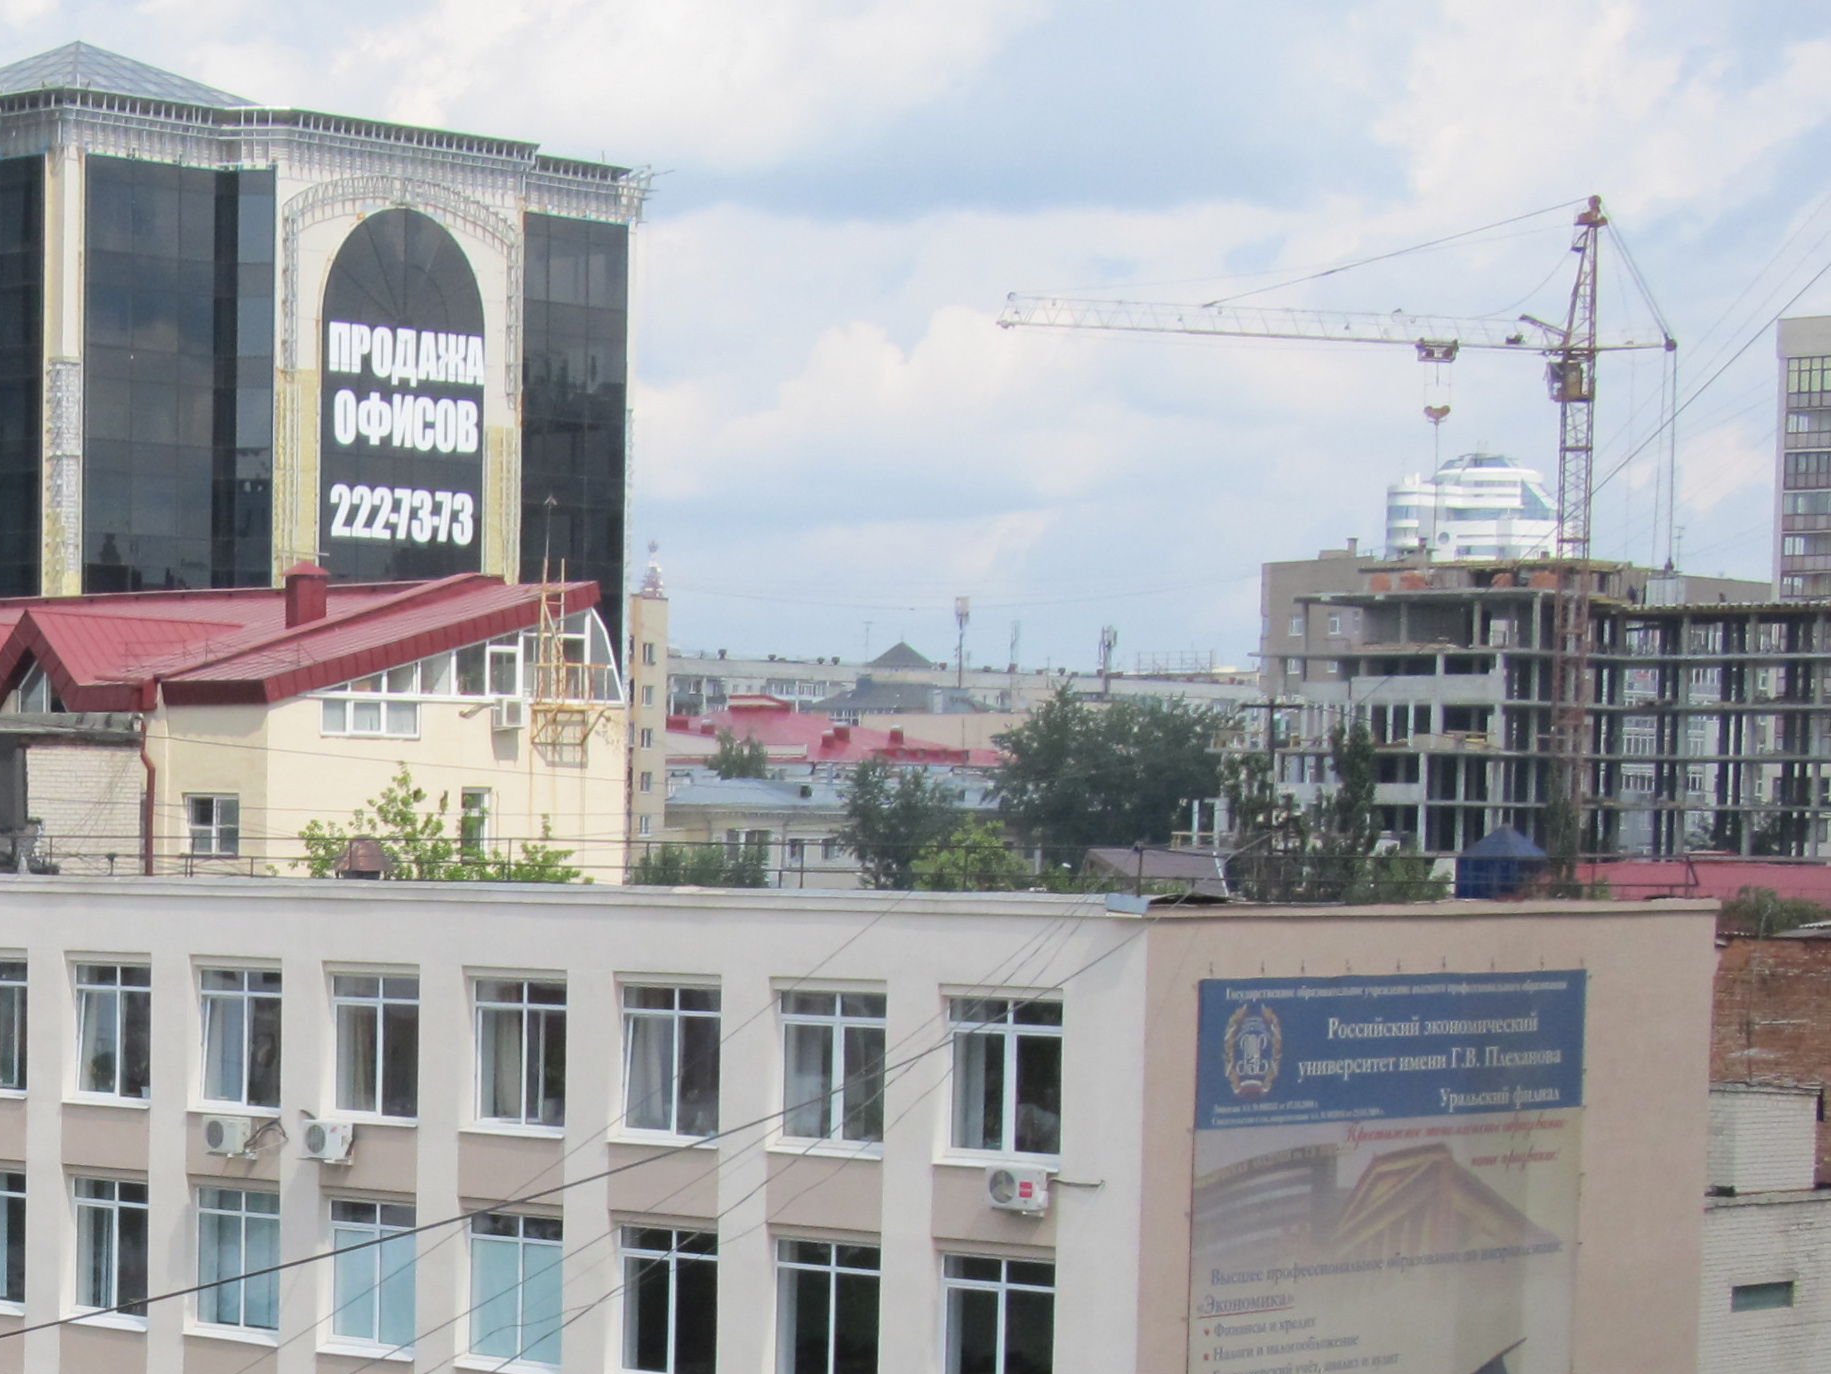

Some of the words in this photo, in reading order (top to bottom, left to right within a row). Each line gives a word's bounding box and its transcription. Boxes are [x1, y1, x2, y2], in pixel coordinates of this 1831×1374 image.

[328, 321, 485, 387] ПРОДАЖА
[333, 388, 479, 454] ОФИСОВ
[329, 482, 475, 546] 222-73-73
[1327, 1014, 1419, 1040] Российский
[1424, 1010, 1539, 1036] экономический
[1297, 1056, 1396, 1083] университет
[1399, 1053, 1447, 1072] имени
[1450, 1047, 1480, 1068] Г.В.
[1484, 1045, 1563, 1067] Плеханова
[1439, 1085, 1510, 1113] Уральский
[1512, 1084, 1561, 1110] филиал
